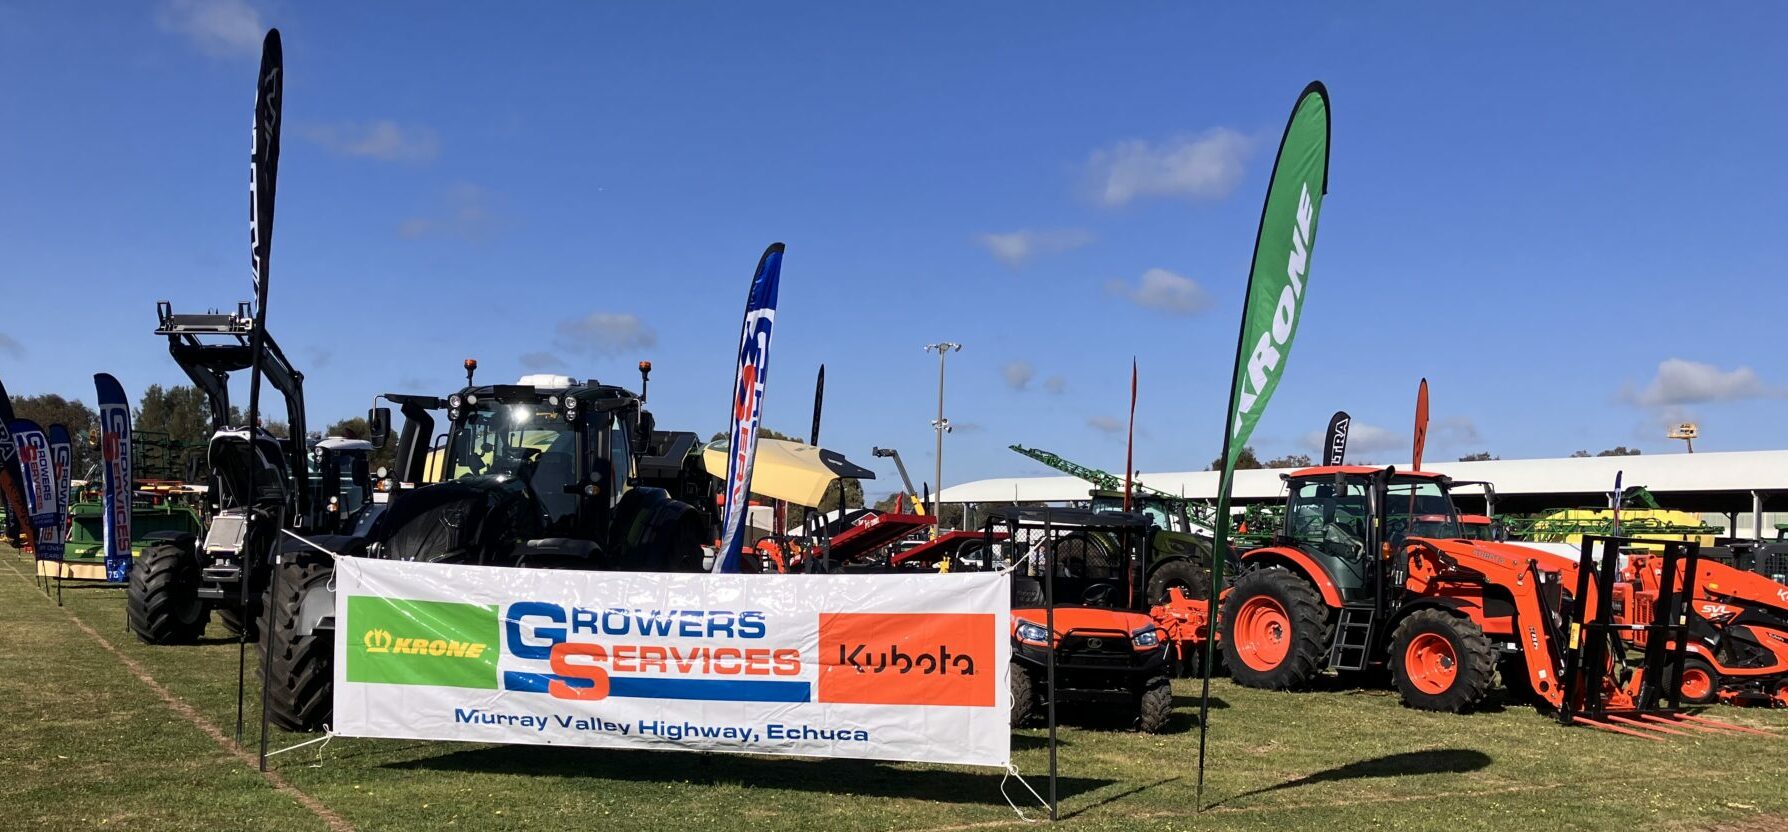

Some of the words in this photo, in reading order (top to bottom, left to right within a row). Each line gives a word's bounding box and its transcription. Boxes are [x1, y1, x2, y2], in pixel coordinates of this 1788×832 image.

[19, 445, 43, 510] SERVICES
[26, 432, 51, 502] GROWERS
[505, 601, 766, 660] GROWERS
[1701, 605, 1731, 613] SVL
[392, 637, 487, 658] KRONE
[839, 644, 974, 675] Kubota
[548, 642, 801, 701] SERVICES
[455, 708, 548, 731] Murray
[554, 713, 631, 736] Valley
[638, 720, 760, 743] Highway,
[767, 724, 869, 742] Echuca
